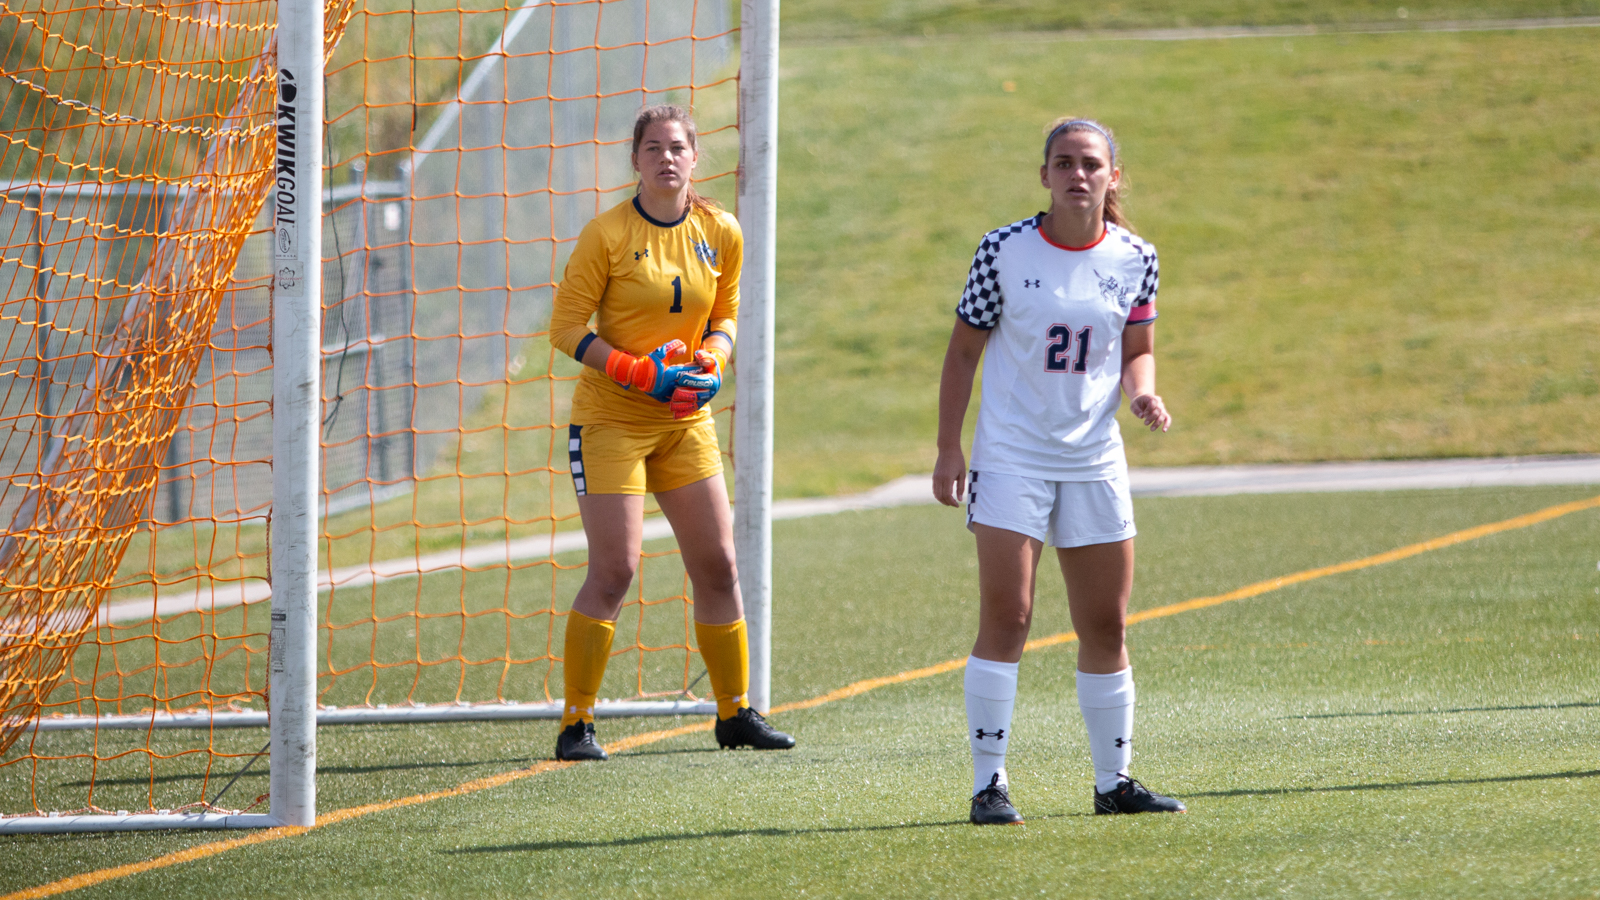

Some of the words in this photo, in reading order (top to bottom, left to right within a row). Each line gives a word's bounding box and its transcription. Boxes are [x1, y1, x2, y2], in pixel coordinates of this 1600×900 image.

[669, 276, 683, 313] 1
[1045, 323, 1093, 374] 21
[683, 378, 714, 387] reusch
